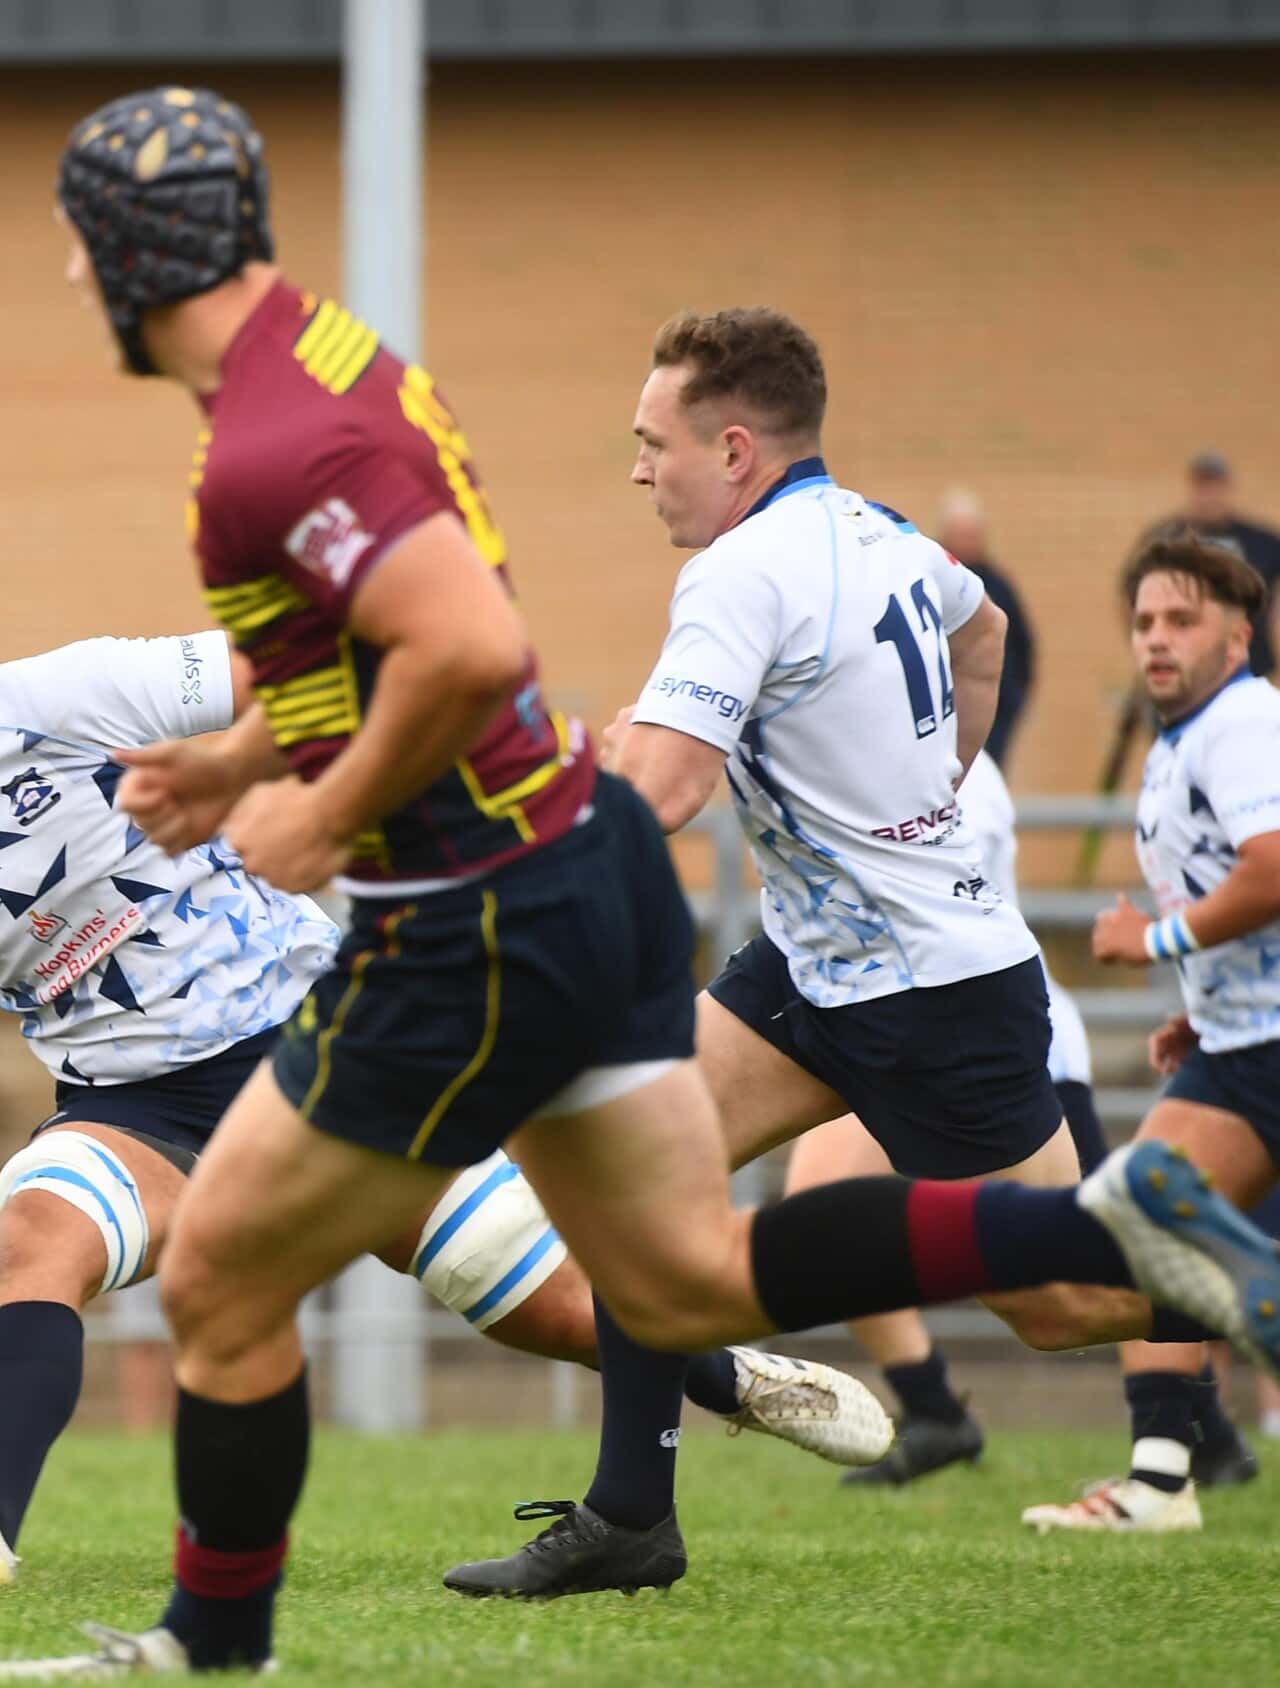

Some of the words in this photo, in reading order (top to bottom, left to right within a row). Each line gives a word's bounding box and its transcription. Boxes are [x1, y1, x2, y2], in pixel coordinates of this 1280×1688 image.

[872, 578, 955, 740] 12
[658, 677, 749, 722] synergy
[34, 908, 107, 981] Hopkins'
[67, 908, 140, 980] Burners
